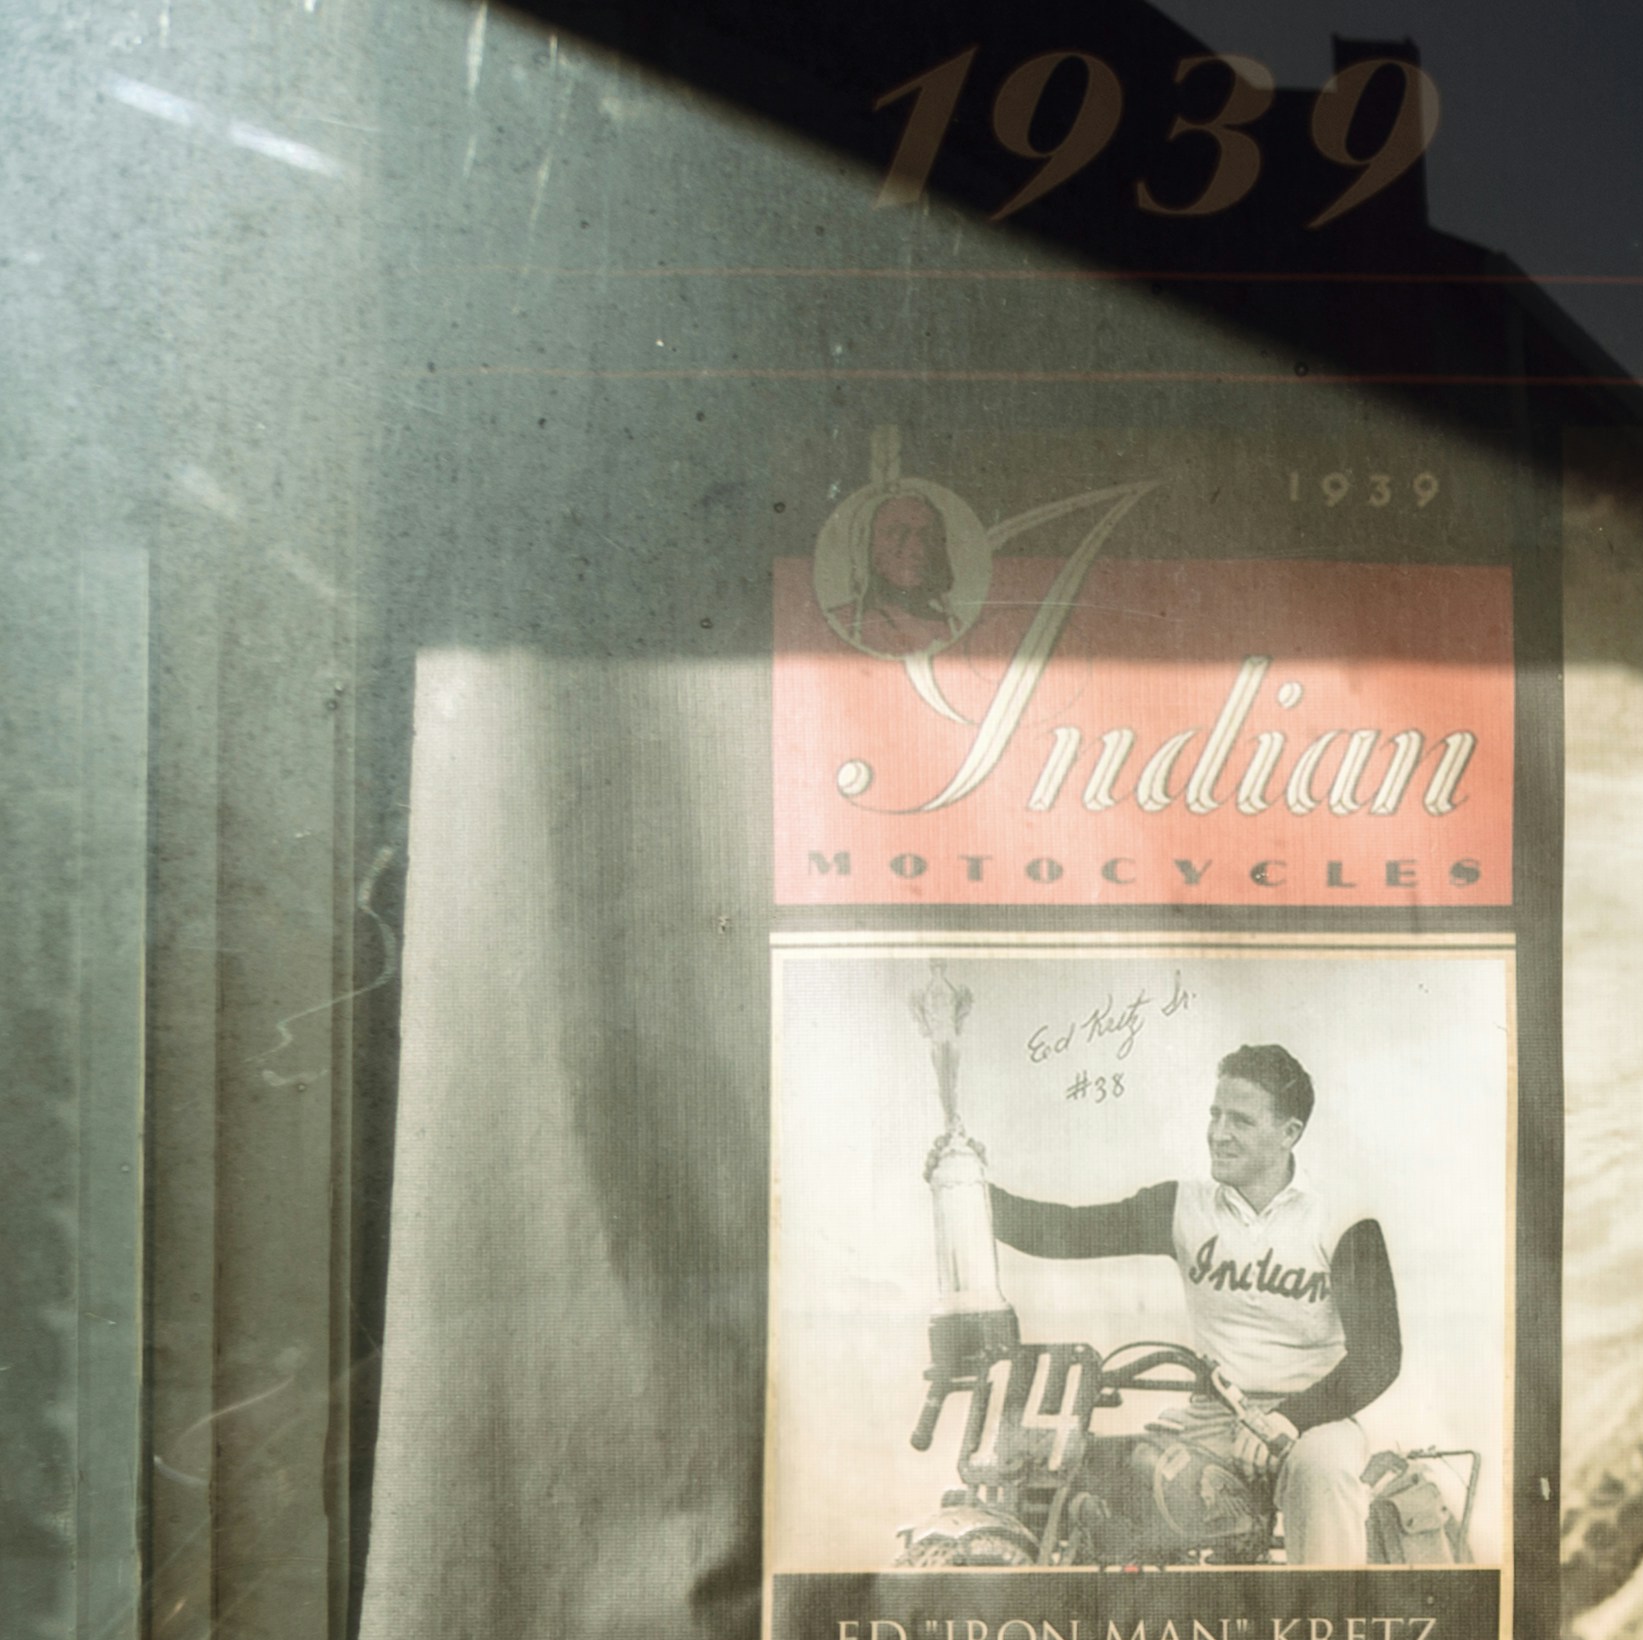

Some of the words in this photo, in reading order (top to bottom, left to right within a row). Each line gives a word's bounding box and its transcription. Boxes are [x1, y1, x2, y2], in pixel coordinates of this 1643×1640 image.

[871, 44, 1442, 230] 1939
[1287, 471, 1441, 508] 1939
[812, 475, 1480, 817] Indian
[806, 850, 1483, 889] MOTOCYCLES
[1027, 1023, 1076, 1063] Ed
[1065, 1070, 1126, 1103] #38
[1189, 1235, 1331, 1303] Indian
